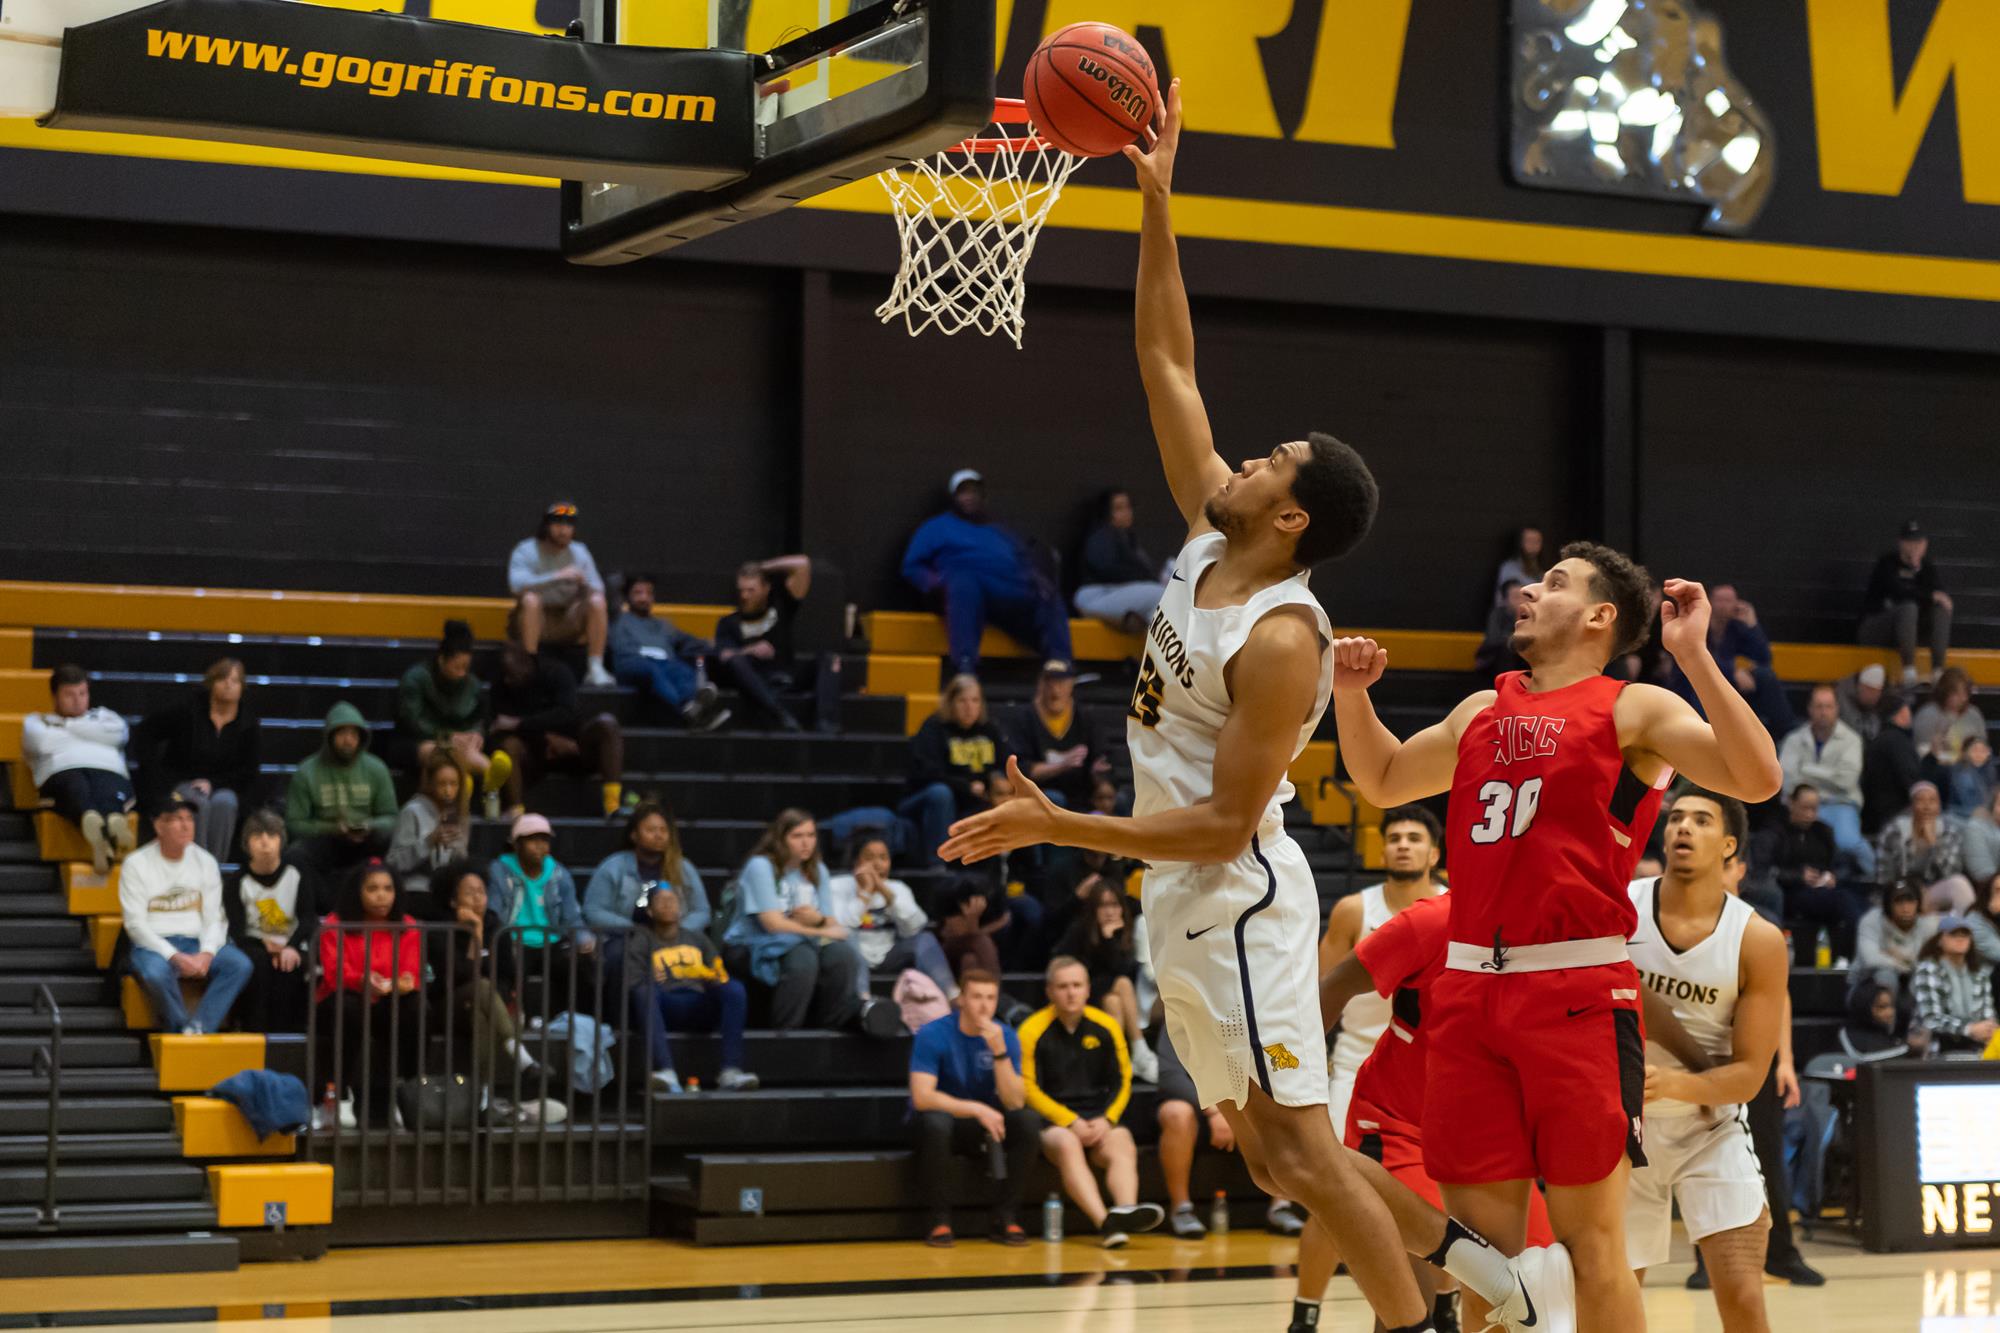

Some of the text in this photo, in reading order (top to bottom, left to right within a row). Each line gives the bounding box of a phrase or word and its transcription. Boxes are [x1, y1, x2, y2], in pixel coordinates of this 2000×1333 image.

[146, 28, 715, 123] www.gogriffons.com
[1077, 55, 1148, 123] Wilson
[1149, 604, 1195, 689] RIFFONS
[1637, 968, 1719, 1005] IFFONS
